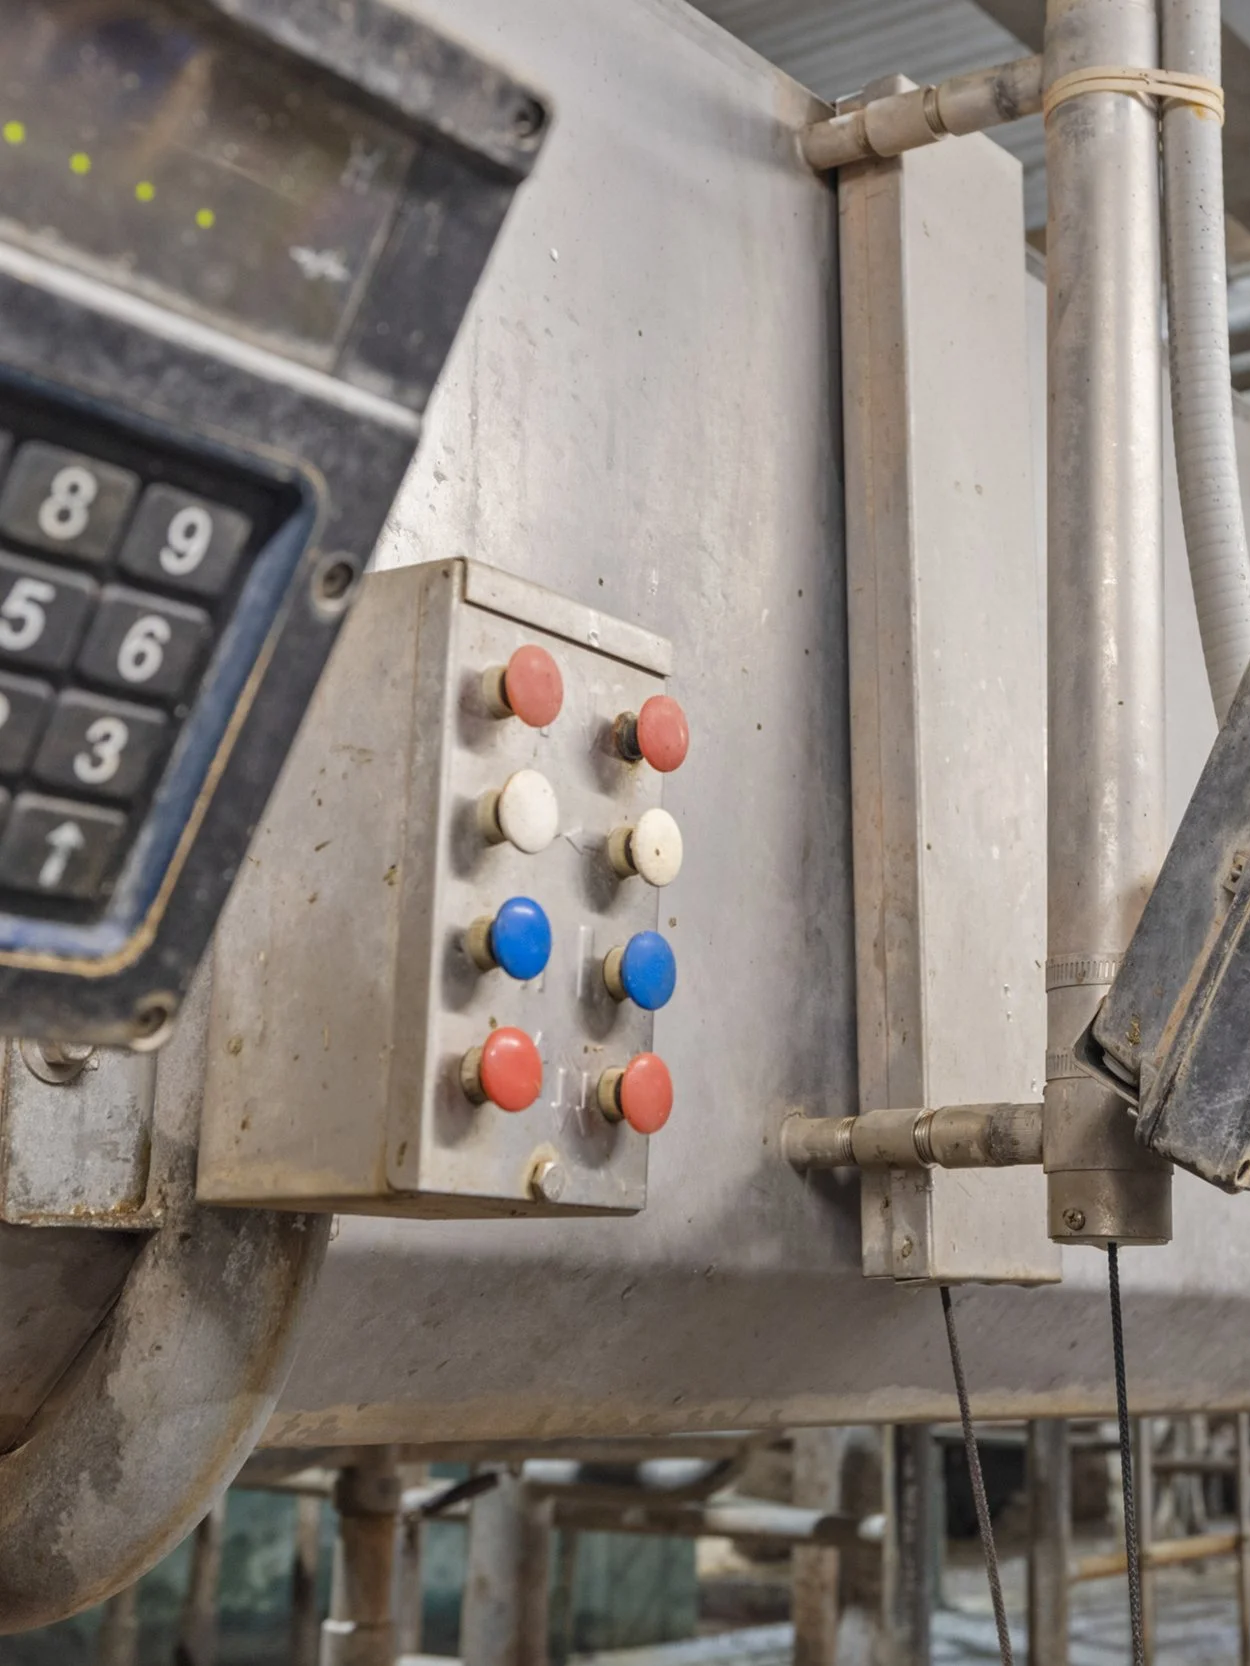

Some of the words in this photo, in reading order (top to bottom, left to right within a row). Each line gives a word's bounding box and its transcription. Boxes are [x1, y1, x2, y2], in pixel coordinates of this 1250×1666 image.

[38, 465, 98, 540] 8
[159, 505, 213, 575] 9
[0, 577, 56, 651] 5
[117, 614, 171, 682] 6
[73, 717, 128, 784] 3
